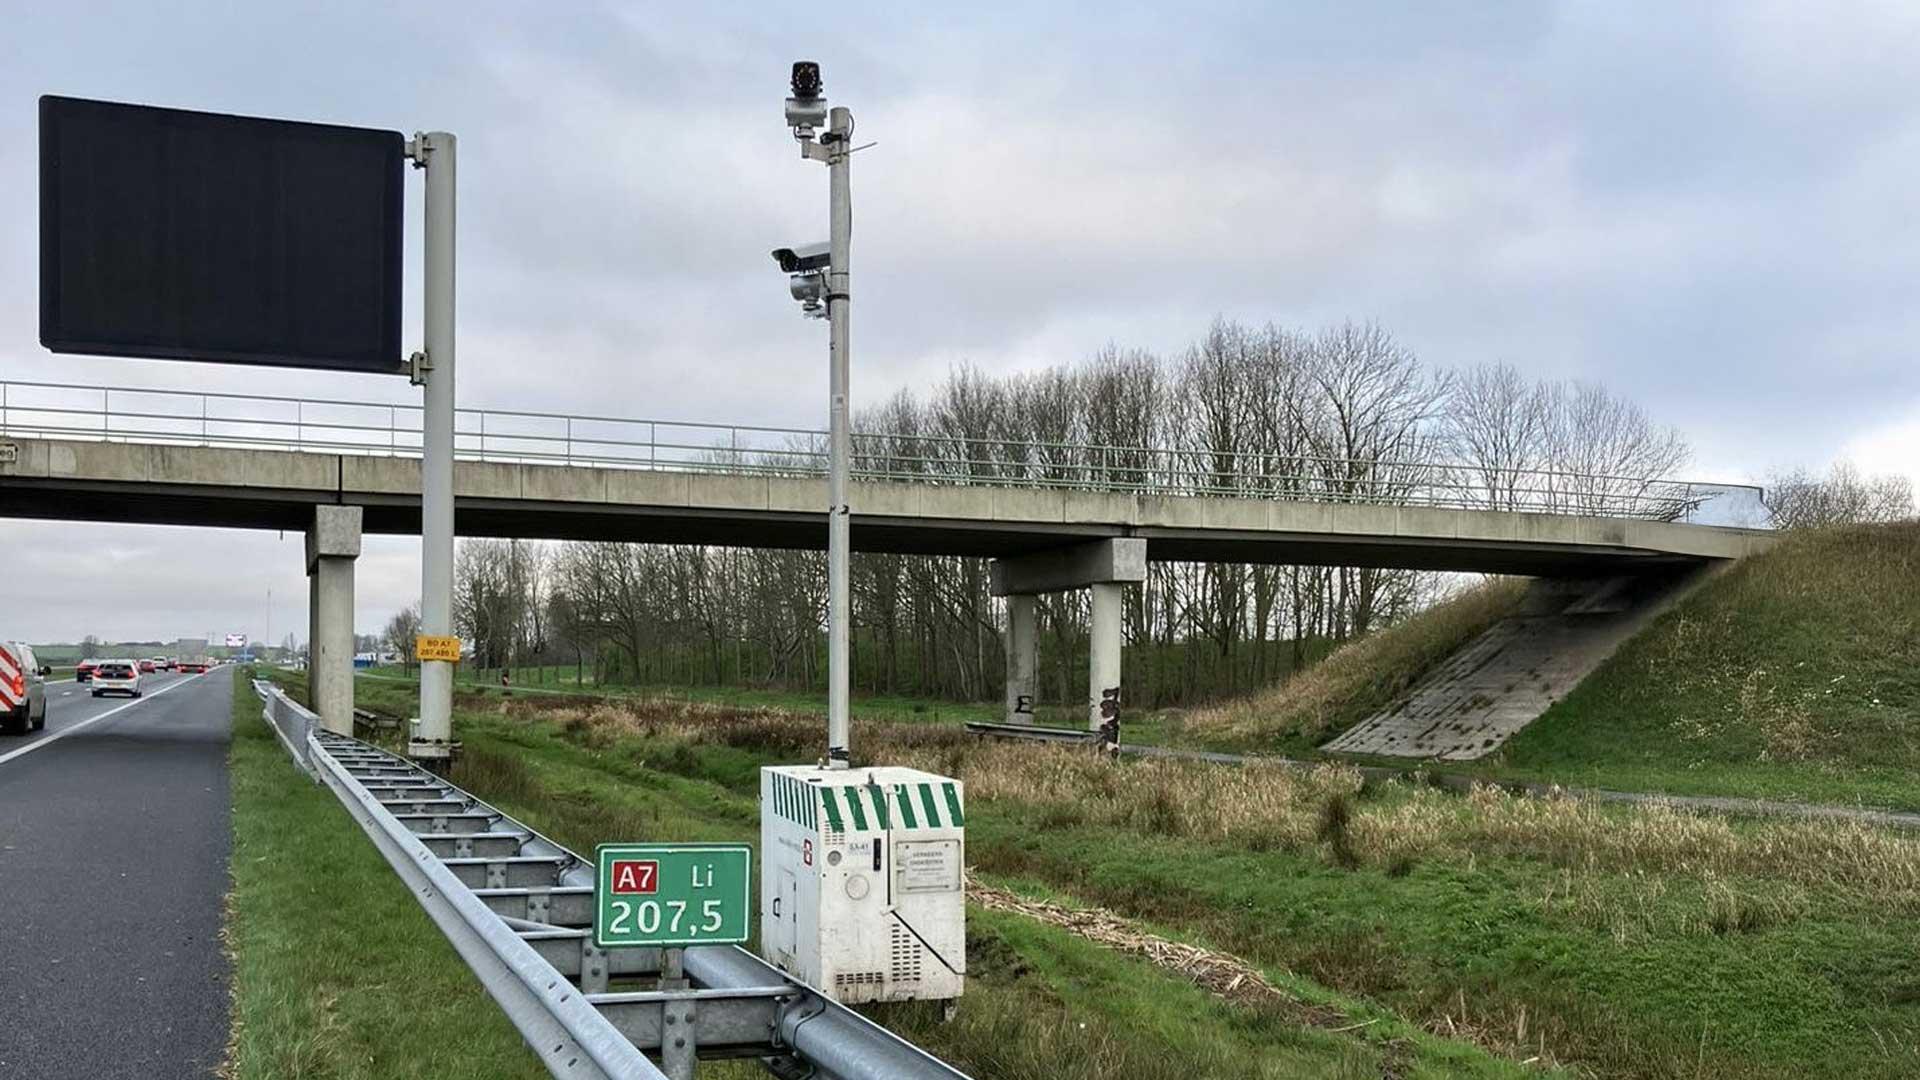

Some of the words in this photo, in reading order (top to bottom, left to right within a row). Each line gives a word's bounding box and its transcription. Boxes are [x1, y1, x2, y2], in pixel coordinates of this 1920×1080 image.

[617, 865, 654, 889] A7
[691, 864, 713, 888] Li
[609, 900, 723, 937] 207,5
